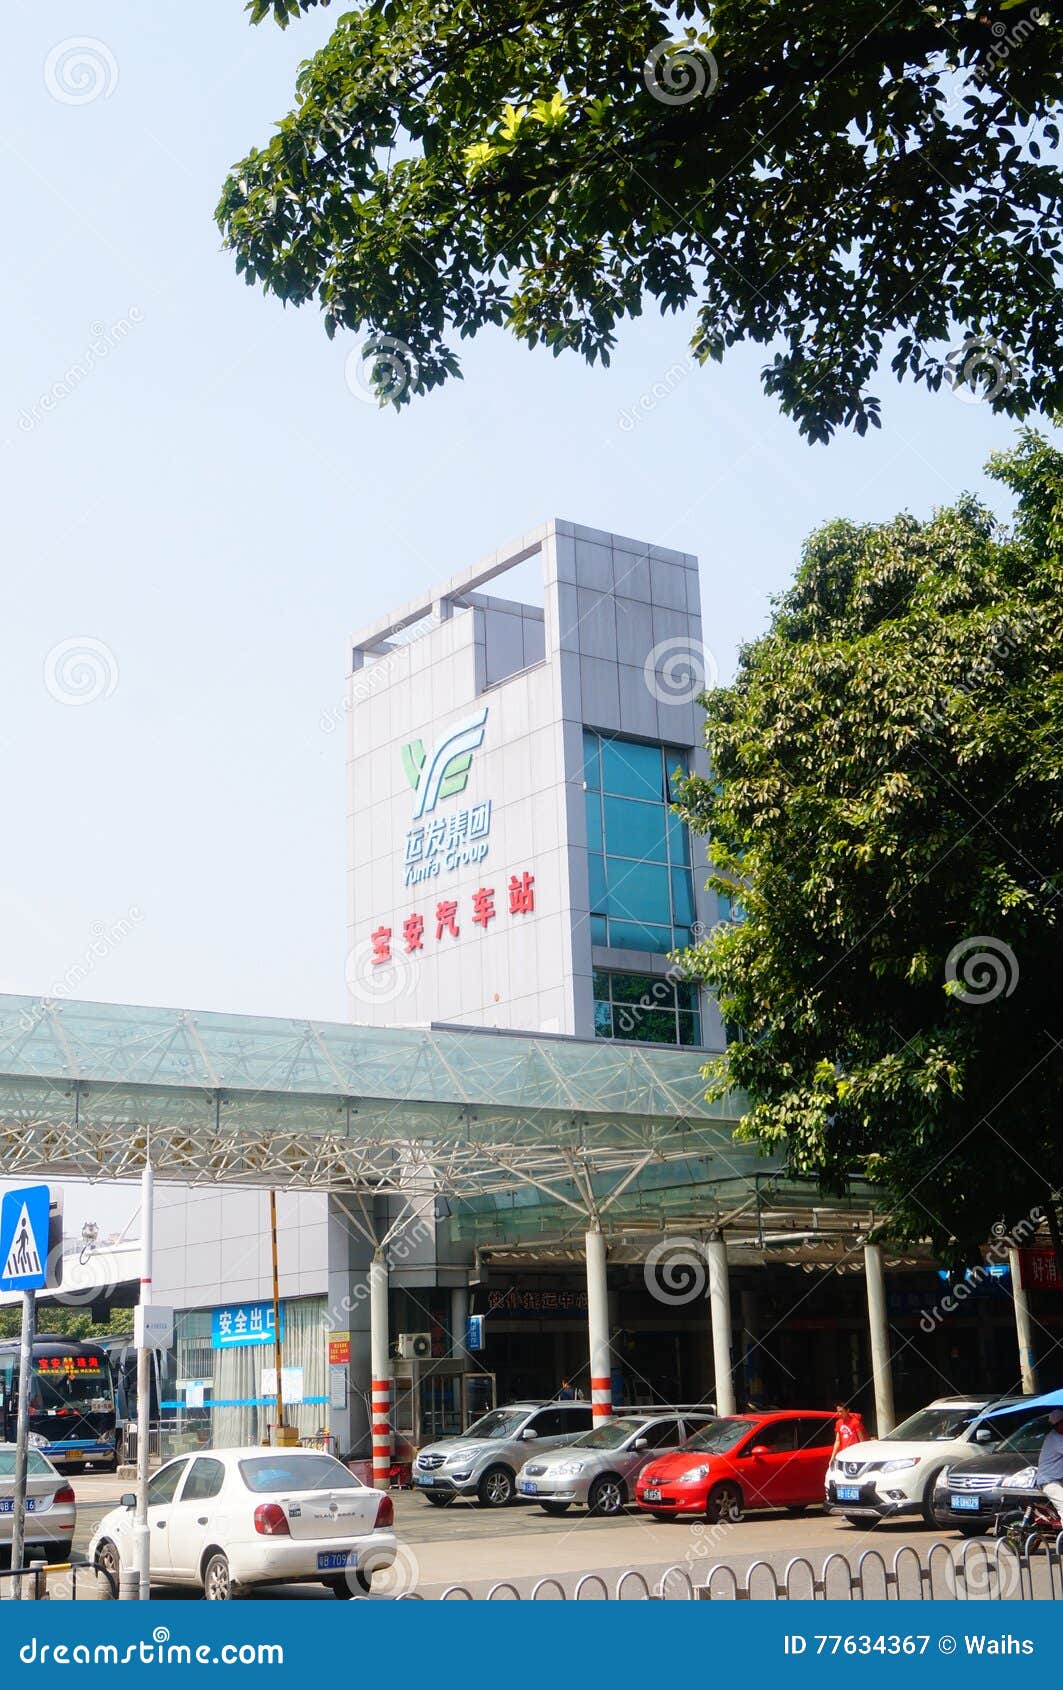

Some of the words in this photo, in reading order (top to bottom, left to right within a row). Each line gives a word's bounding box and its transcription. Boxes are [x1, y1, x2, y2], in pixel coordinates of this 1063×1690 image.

[404, 800, 492, 864] 运发集团
[403, 857, 440, 887] Yunfa
[445, 841, 489, 871] Group
[370, 871, 536, 967] 宝安汽车站
[218, 1307, 277, 1336] 安全出口
